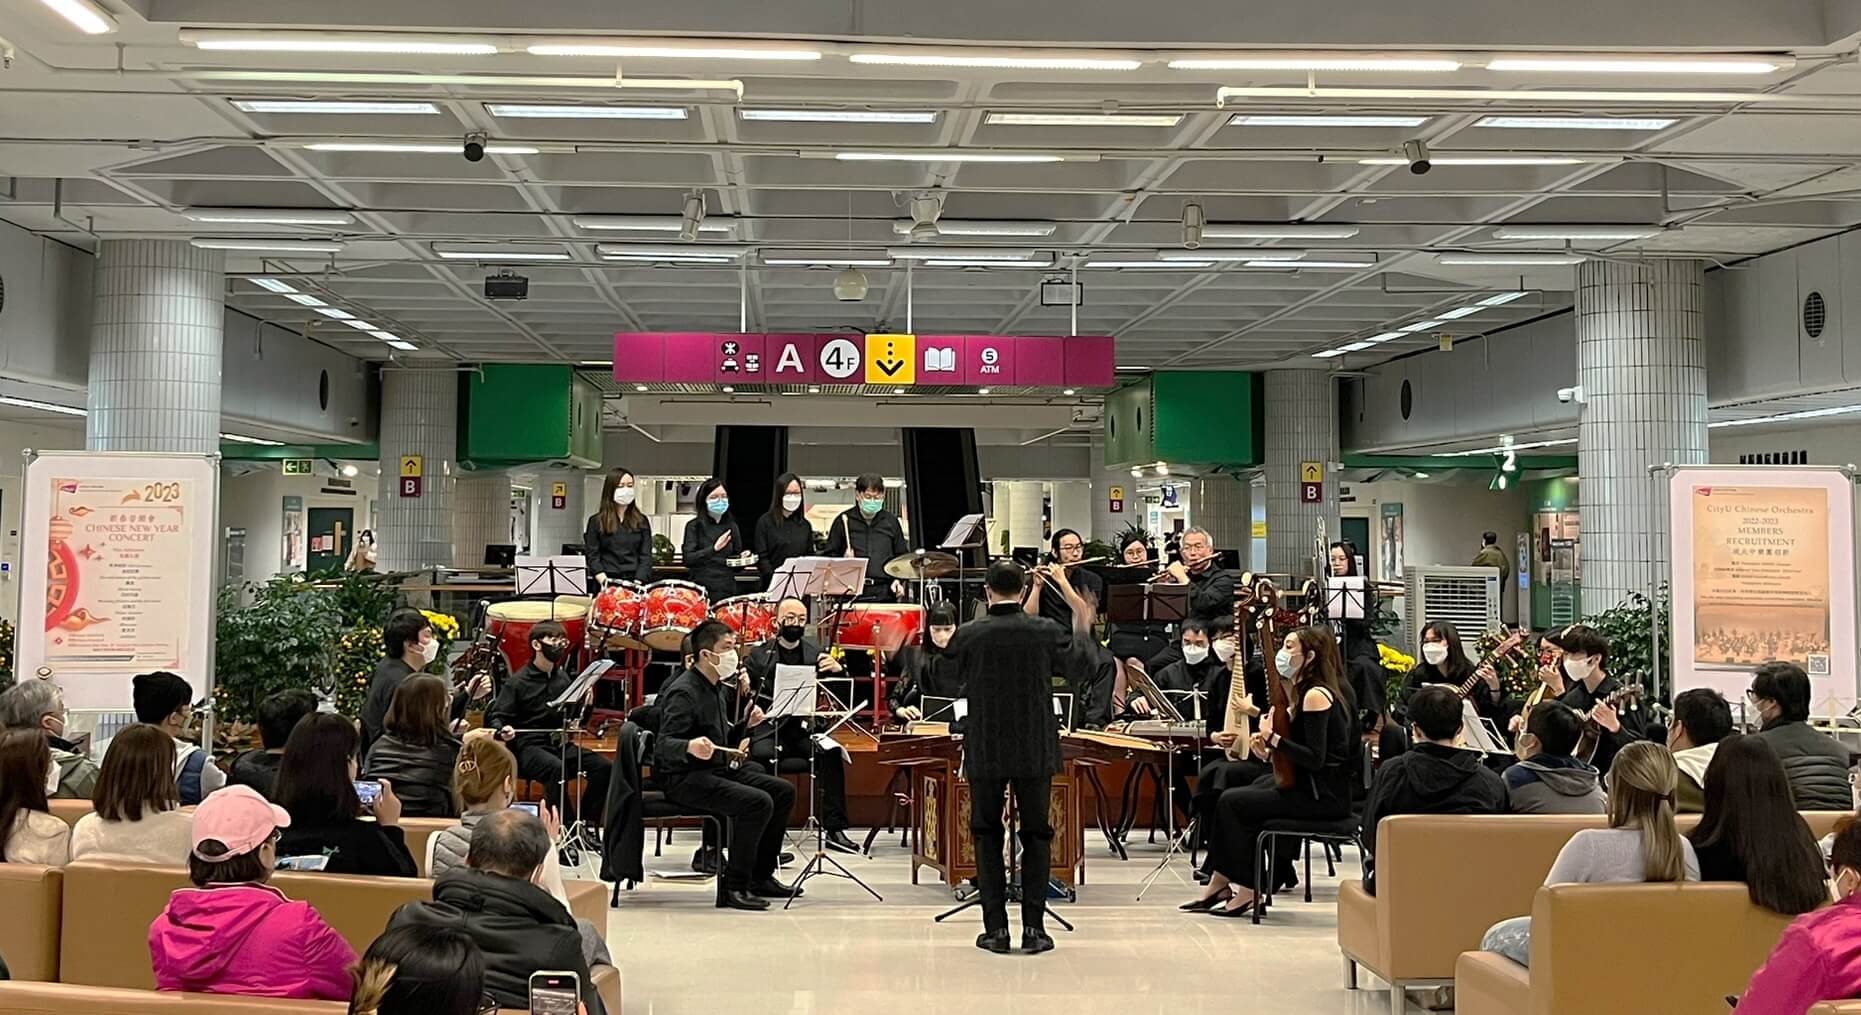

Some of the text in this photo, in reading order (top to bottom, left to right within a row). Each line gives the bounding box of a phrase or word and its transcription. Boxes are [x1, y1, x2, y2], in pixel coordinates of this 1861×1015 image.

[775, 343, 805, 373] A
[825, 346, 856, 370] 4F
[980, 365, 1000, 374] ATM
[405, 480, 415, 494] B
[144, 482, 180, 503] 2023
[1307, 486, 1317, 499] B
[555, 497, 562, 507] B
[1112, 501, 1120, 510] B
[1706, 504, 1814, 514] CityU Chinese Orchestra
[86, 524, 179, 533] CHINESE NEW YEAR
[1738, 527, 1784, 535] MEMBERS
[108, 533, 155, 542] CONCERT
[1726, 537, 1796, 546] RECRUITMENT
